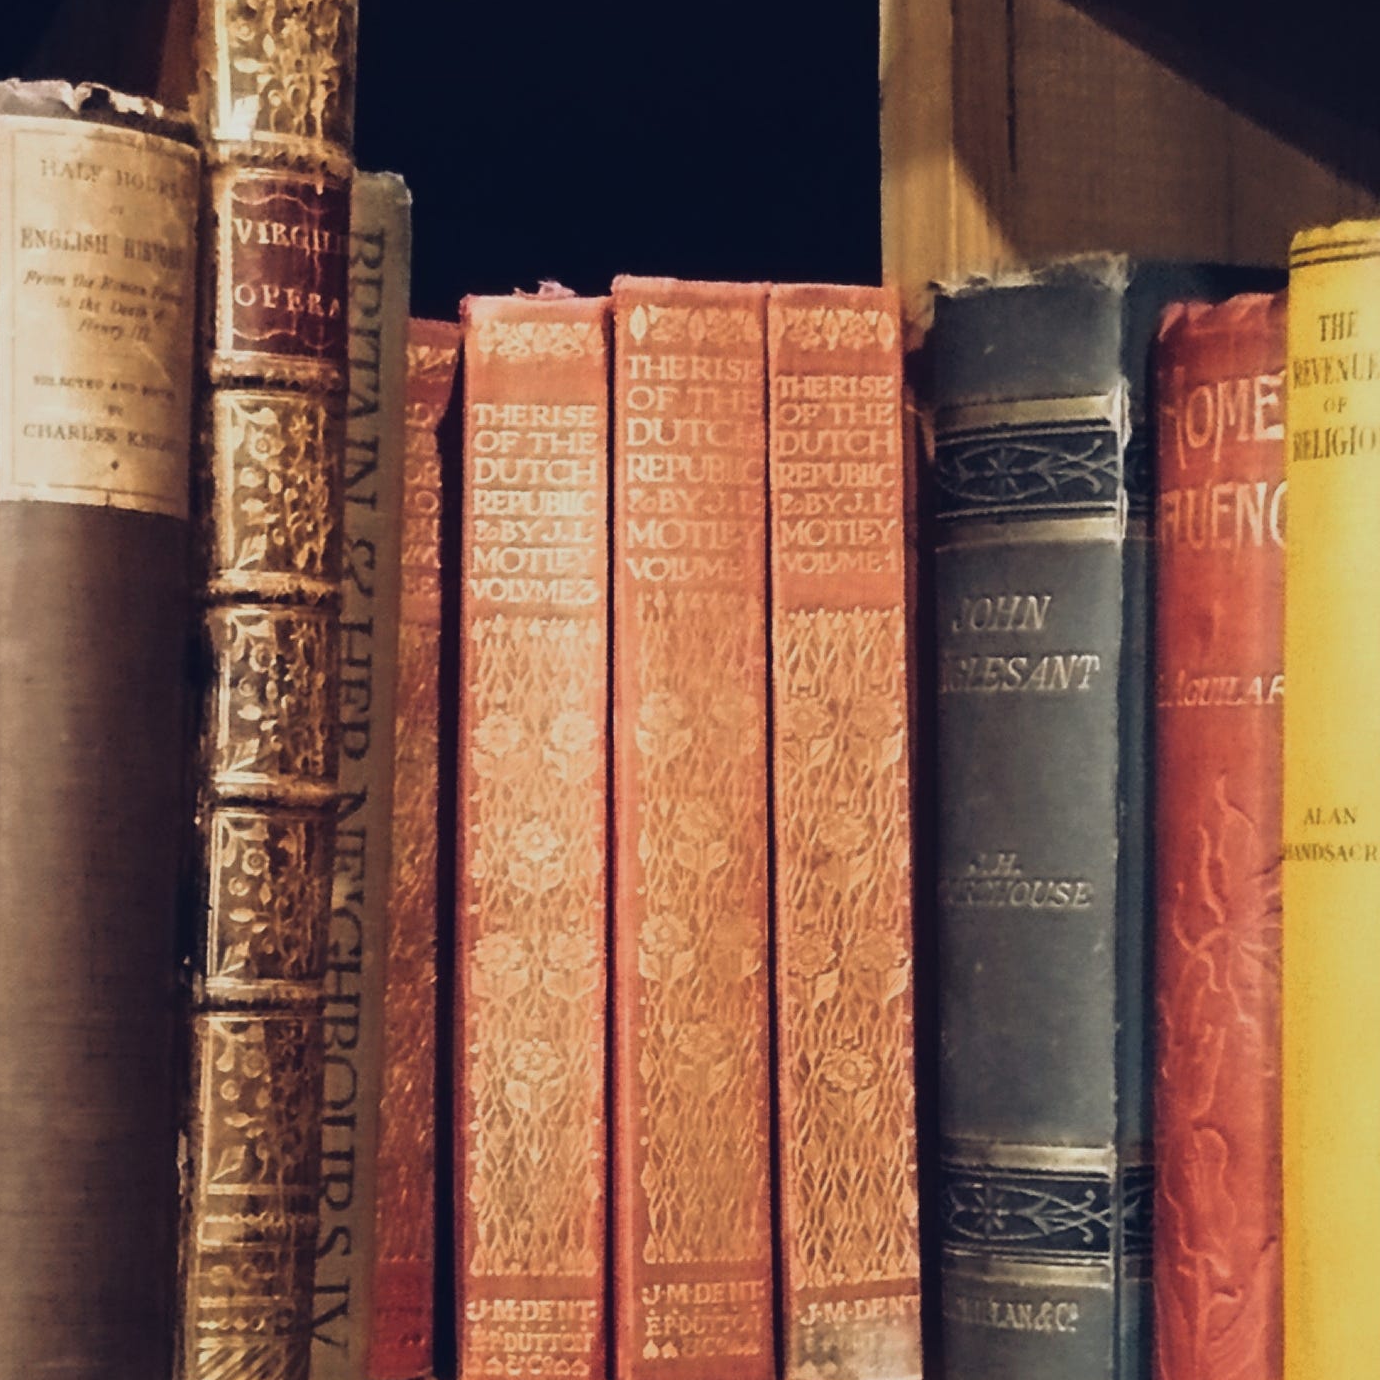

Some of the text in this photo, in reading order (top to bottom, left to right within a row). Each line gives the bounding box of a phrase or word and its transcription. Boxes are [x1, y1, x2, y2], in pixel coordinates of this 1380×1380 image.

[20, 227, 109, 255] ENGLISH
[234, 283, 342, 319] OPERA
[1317, 310, 1360, 344] THE
[628, 355, 761, 382] THE RISE
[626, 386, 761, 414] OF THE
[778, 375, 894, 399] THE RISE
[473, 403, 598, 428] THE RISE
[779, 402, 895, 426] OF THE
[1323, 396, 1348, 415] OF
[23, 423, 118, 445] CHARLES
[473, 430, 598, 455] OF THE
[626, 417, 761, 448] DUTCH
[778, 429, 894, 456] DUTCH
[473, 457, 598, 485] DUTCH
[626, 454, 763, 485] REPUBLIC
[778, 462, 895, 488] REPUBLIC
[473, 488, 597, 516] REPUBLIC
[658, 488, 702, 514] BY
[812, 493, 844, 515] BY
[500, 520, 538, 543] BY
[627, 519, 763, 551] MOTLEY
[780, 519, 899, 548] MOTLEY
[473, 546, 596, 574] MOTLEY
[952, 595, 1052, 632] JOHN
[1304, 807, 1356, 825] ALAN
